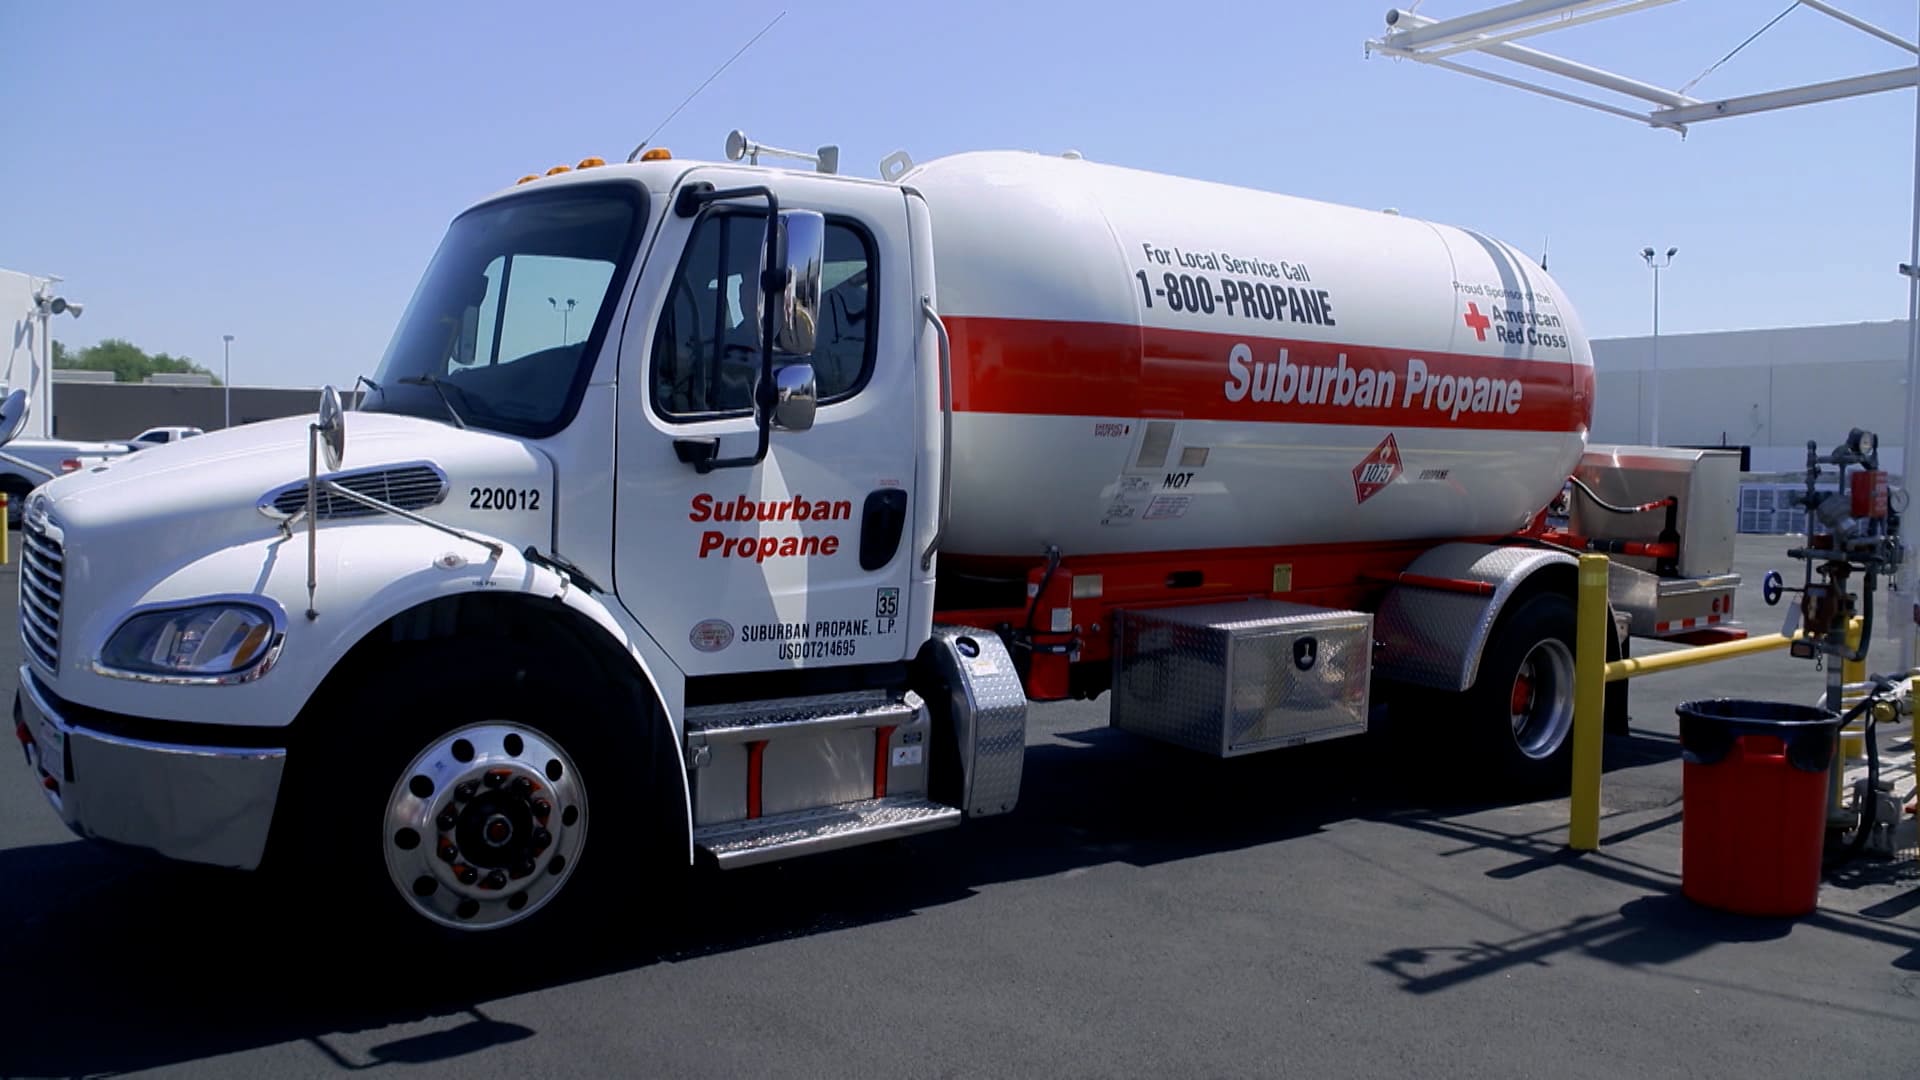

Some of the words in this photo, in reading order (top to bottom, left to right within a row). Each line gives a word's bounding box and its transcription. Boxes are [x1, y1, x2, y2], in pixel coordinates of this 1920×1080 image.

[1142, 243, 1171, 265] For
[1175, 248, 1219, 271] Local
[1222, 253, 1279, 278] Service
[1281, 261, 1310, 281] Call
[1136, 269, 1336, 325] 1-800-PROPANE
[1453, 281, 1483, 296] Proud
[1484, 285, 1524, 299] Sponsor
[1536, 292, 1552, 304] the
[1493, 304, 1561, 327] American
[1496, 325, 1525, 344] Red
[1527, 328, 1567, 348] Cross
[1225, 343, 1396, 408] Suburban
[1402, 359, 1523, 421] Propane
[1363, 464, 1392, 482] 1075
[470, 487, 541, 510] 220012
[689, 493, 852, 522] Suburban
[699, 531, 840, 563] Propane
[878, 596, 896, 614] 35
[742, 623, 810, 642] SUBURBAN
[779, 640, 855, 660] USDOT214695
